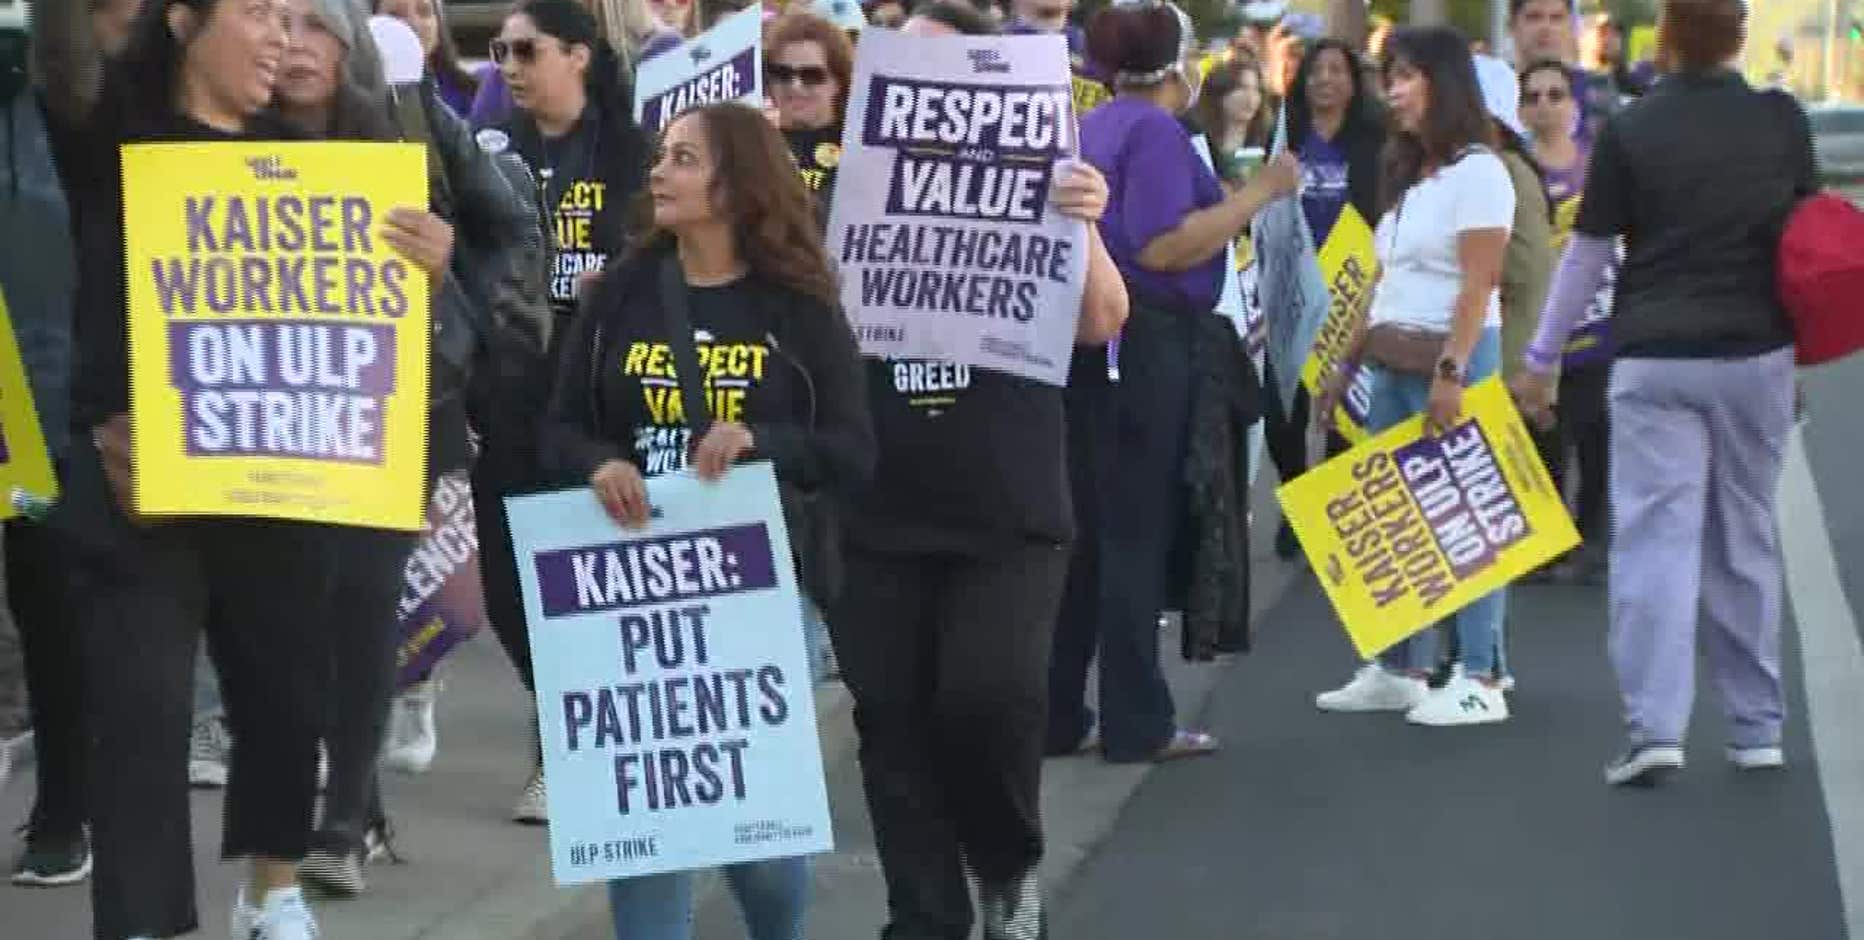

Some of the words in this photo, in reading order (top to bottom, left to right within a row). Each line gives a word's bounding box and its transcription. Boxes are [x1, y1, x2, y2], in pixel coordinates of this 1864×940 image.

[880, 83, 1070, 149] RESPECT
[901, 159, 1043, 218] VALUE
[184, 195, 374, 253] KAISER
[841, 223, 1073, 284] HEALTHCARE
[151, 256, 409, 318] WORKERS
[860, 268, 1038, 322] WORKERS
[189, 325, 265, 385] ON
[278, 326, 378, 388] ULP
[893, 362, 971, 393] GREED
[191, 391, 378, 458] STRIKE
[1403, 454, 1462, 521] ULP
[1440, 425, 1527, 545] STRIKE
[1325, 490, 1409, 608] KAISER
[1351, 451, 1454, 609] WORKERS
[1434, 509, 1487, 567] ON
[570, 536, 742, 609] KAISER:
[619, 604, 711, 675] PUT
[561, 665, 789, 751] PATIENTS
[614, 738, 749, 816] FIRST
[570, 843, 599, 865] ULP
[603, 837, 657, 862] STRIKE
